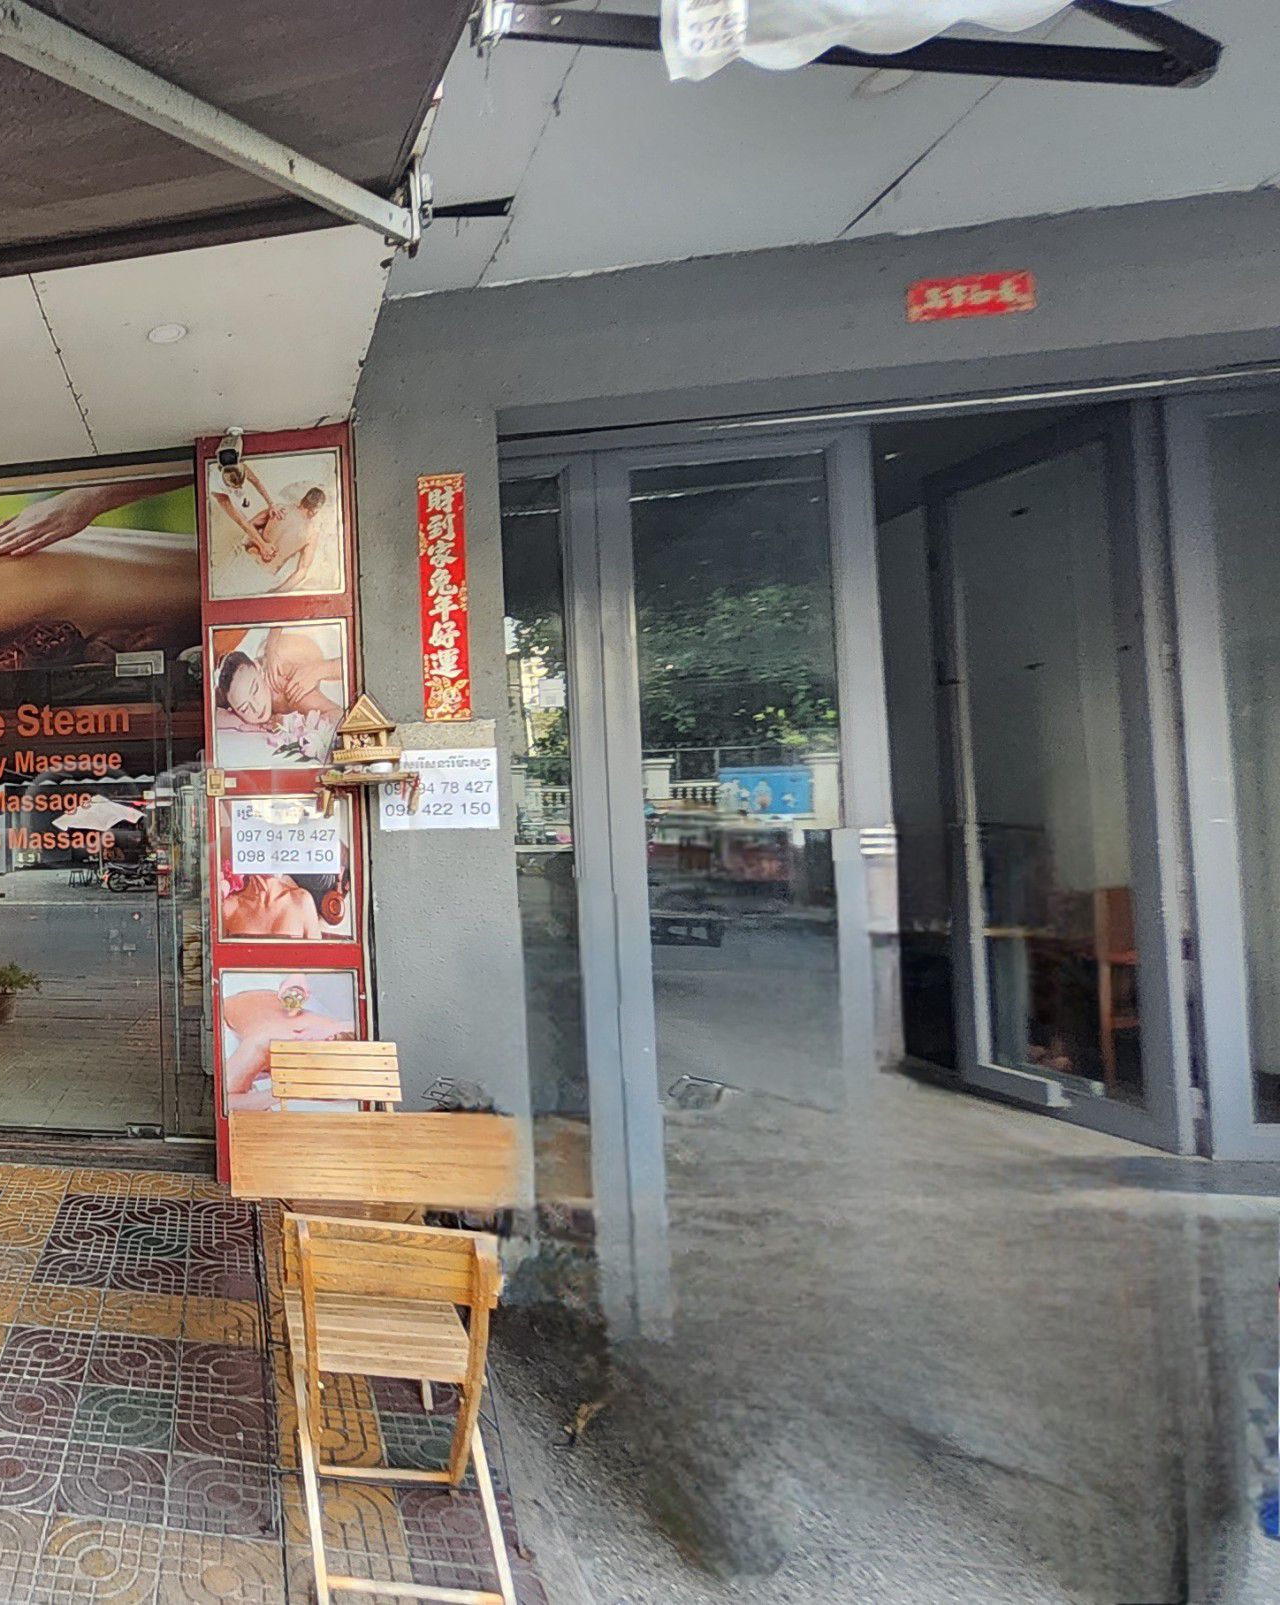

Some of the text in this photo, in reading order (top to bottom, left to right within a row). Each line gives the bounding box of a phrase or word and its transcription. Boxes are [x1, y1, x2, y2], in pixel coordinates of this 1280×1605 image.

[16, 704, 131, 739] Steam
[14, 751, 122, 778] Massage
[384, 781, 413, 797] 09
[440, 781, 460, 794] 78
[464, 780, 493, 794] 427
[421, 802, 454, 816] 422
[460, 802, 491, 815] 150
[7, 827, 116, 854] Massage
[236, 828, 336, 842] 097 94 78 427
[237, 849, 334, 863] 098 422 150
